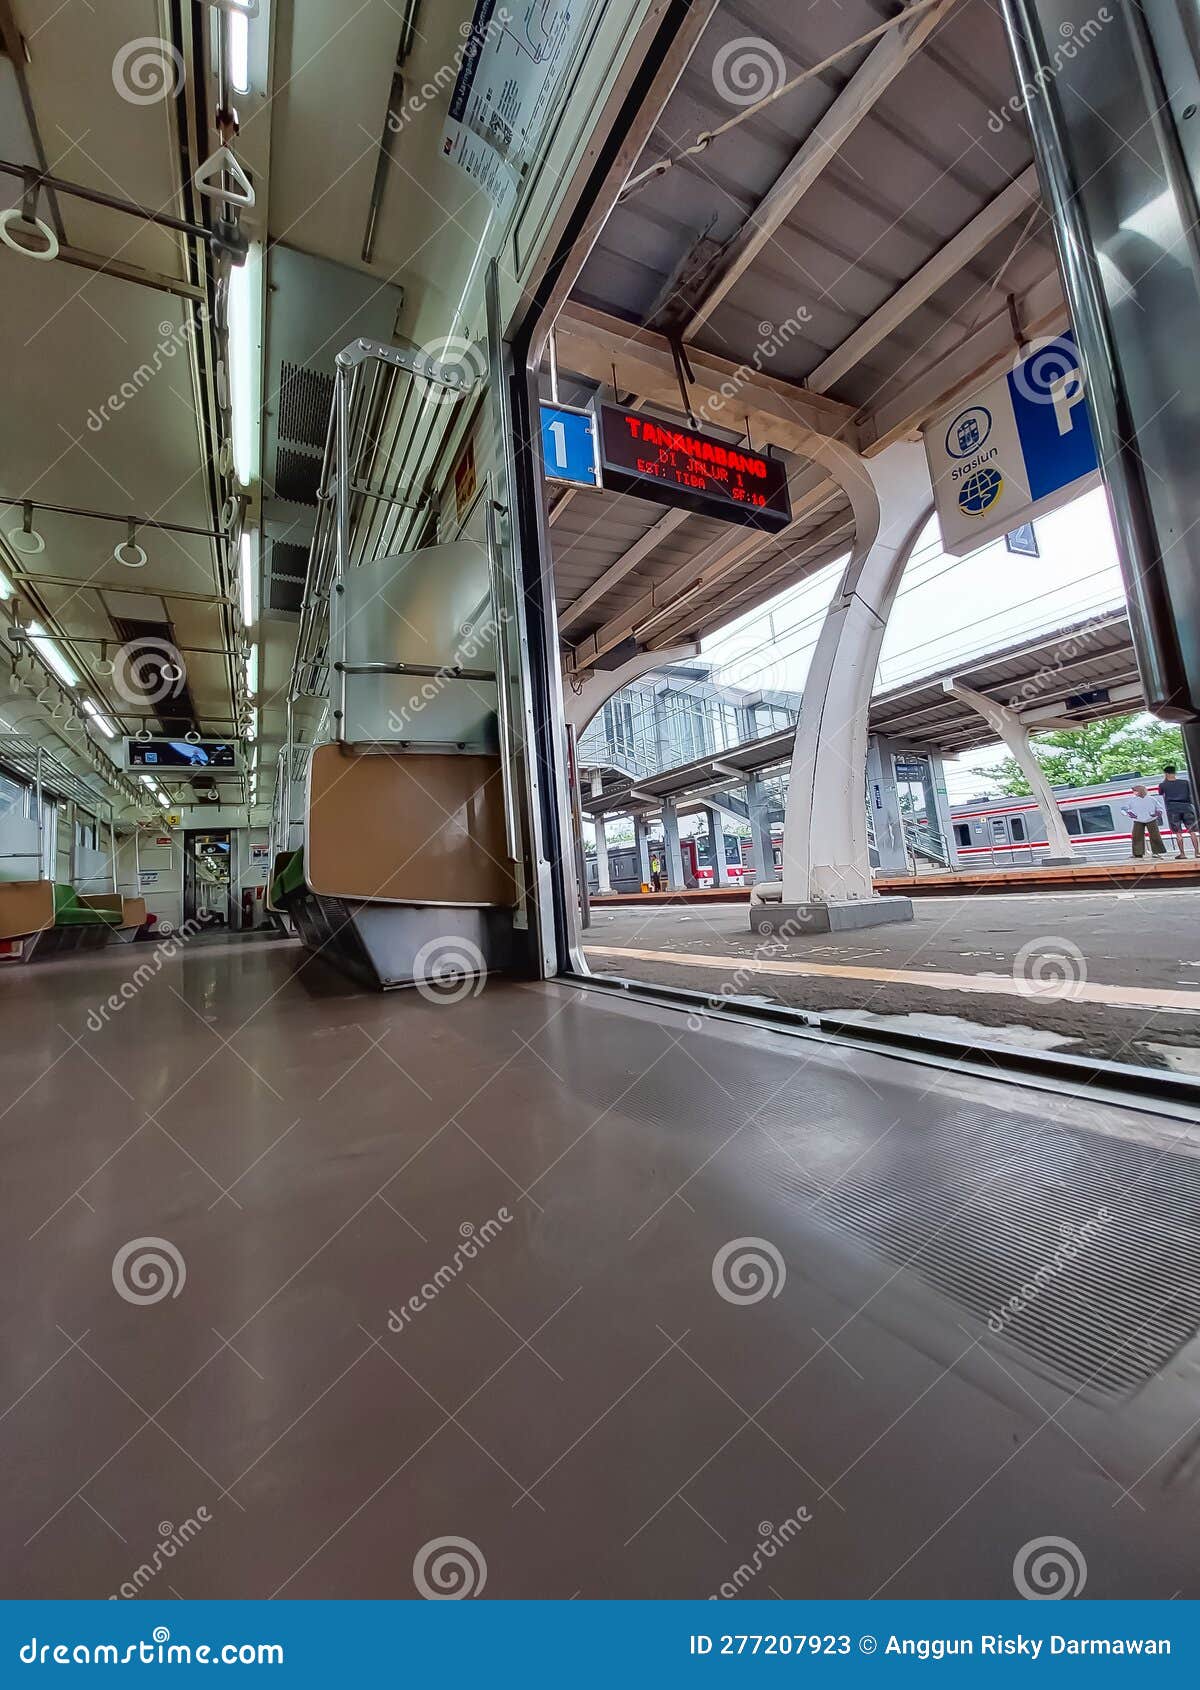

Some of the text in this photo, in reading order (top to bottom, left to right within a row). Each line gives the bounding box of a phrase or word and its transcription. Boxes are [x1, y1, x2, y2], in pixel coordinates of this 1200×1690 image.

[548, 421, 567, 468] 1
[951, 446, 998, 481] Stasiun
[170, 816, 176, 824] 5
